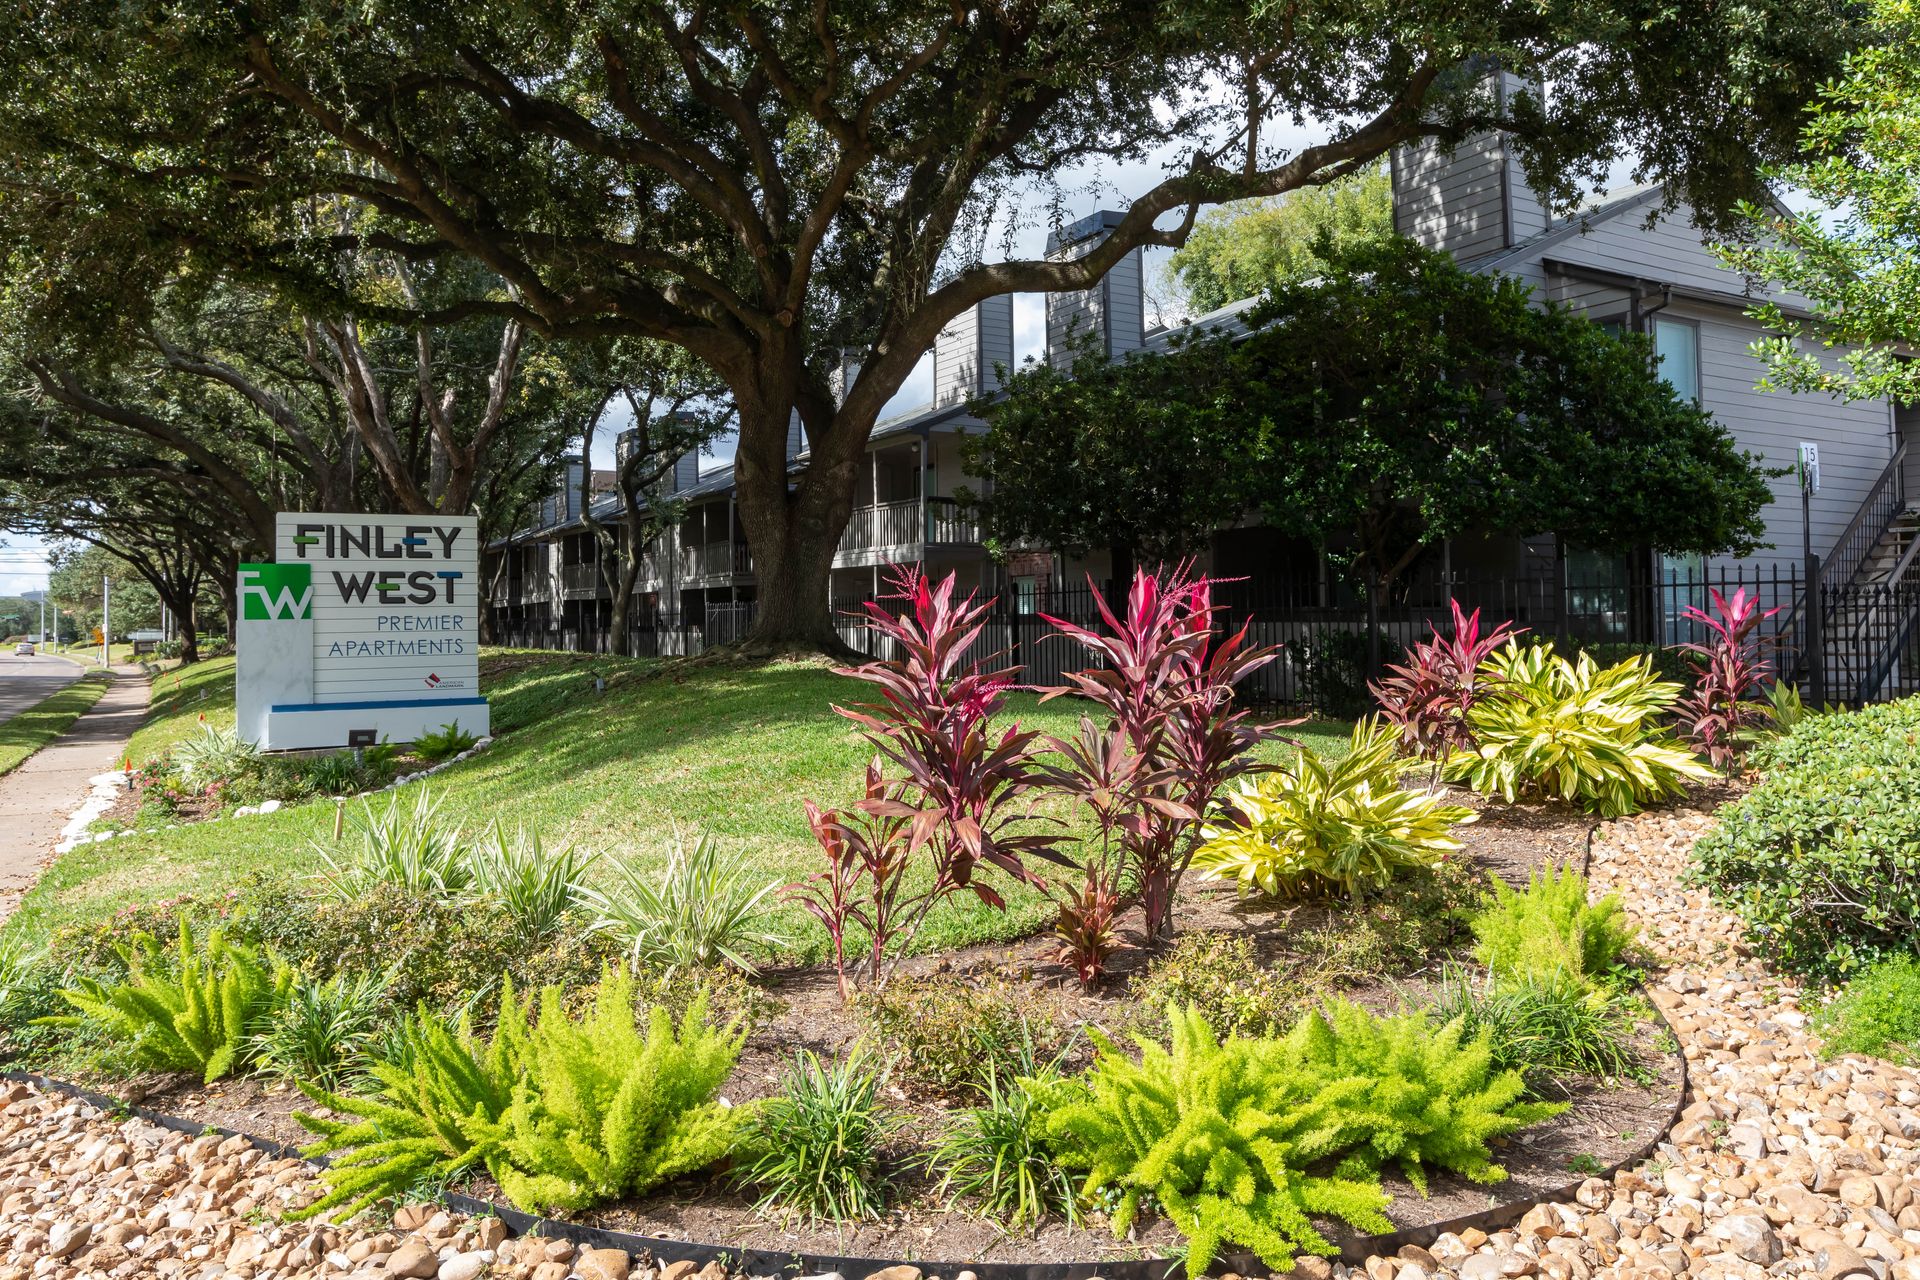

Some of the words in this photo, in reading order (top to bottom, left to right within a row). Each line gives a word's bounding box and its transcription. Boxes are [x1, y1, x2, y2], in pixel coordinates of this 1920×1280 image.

[1805, 447, 1816, 462] 15
[293, 524, 462, 559] FINLEY
[237, 571, 314, 620] FW
[332, 571, 463, 604] WEST
[378, 615, 464, 631] PREMIER
[329, 638, 464, 657] APARTMENTS
